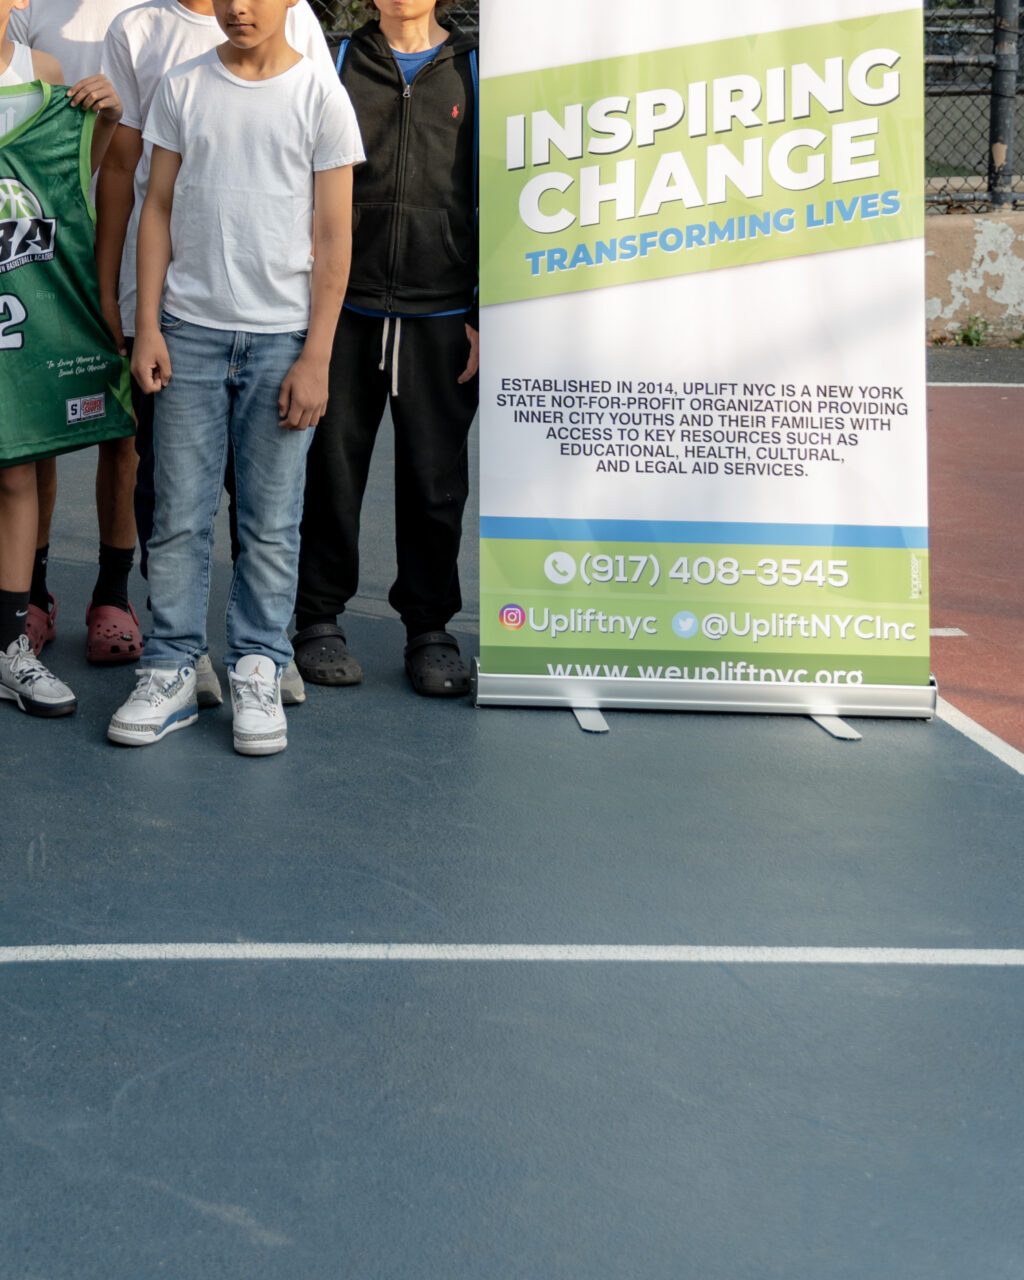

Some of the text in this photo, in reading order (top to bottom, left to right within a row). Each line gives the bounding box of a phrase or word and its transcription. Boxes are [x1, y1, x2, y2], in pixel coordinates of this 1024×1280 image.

[506, 48, 902, 171] INSPIRING
[518, 117, 881, 234] CHANGE
[525, 190, 901, 276] TRANSFORMING LIVES
[6, 256, 34, 271] BASKETBALL
[501, 378, 904, 400] ESTABLISHED IN 2014, UPLIFT NYC IS A NEW YORK
[496, 393, 908, 416] STATE NOT-FOR-PROFIT ORGANIZATION PROVIDING
[513, 410, 891, 431] INNER CITY YOUTHS AND THEIR FAMILIES WITH
[545, 426, 858, 446] ACCESS TO KEY RESOURCES SUCH AS
[560, 442, 844, 462] EDUCATIONAL, HEALTH, CULTURAL,
[596, 459, 808, 477] AND LEGAL AID SERVICES.
[579, 552, 849, 588] (917) 408-3545
[528, 607, 916, 642] Upliftnyc @UpliftNYCInc
[547, 661, 864, 685] wwwweupliftnyc.org
